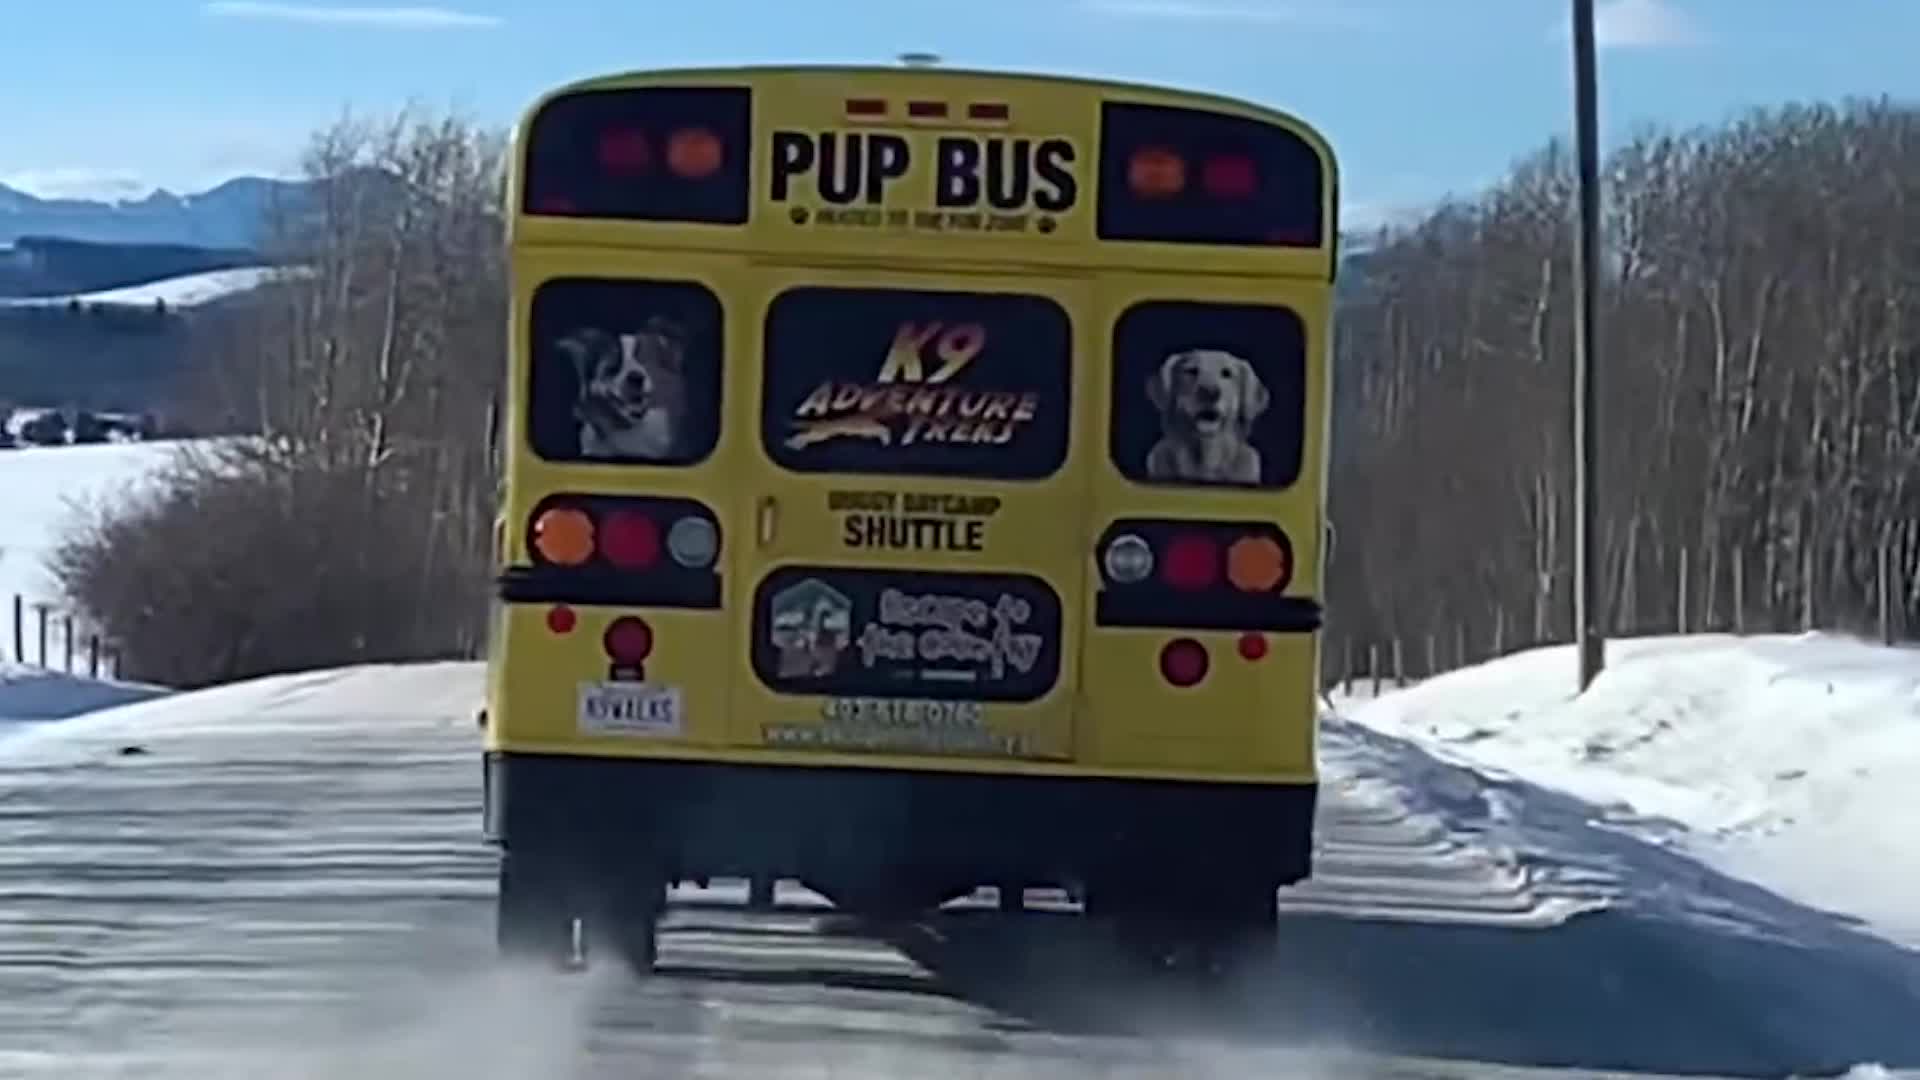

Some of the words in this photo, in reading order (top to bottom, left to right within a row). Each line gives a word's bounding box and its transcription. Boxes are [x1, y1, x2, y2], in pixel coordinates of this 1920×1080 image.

[770, 131, 910, 204] PUP
[935, 137, 1077, 213] BUS
[878, 321, 985, 383] K9
[795, 382, 1039, 421] ADVENTURE
[844, 514, 984, 551] SHUTTLE
